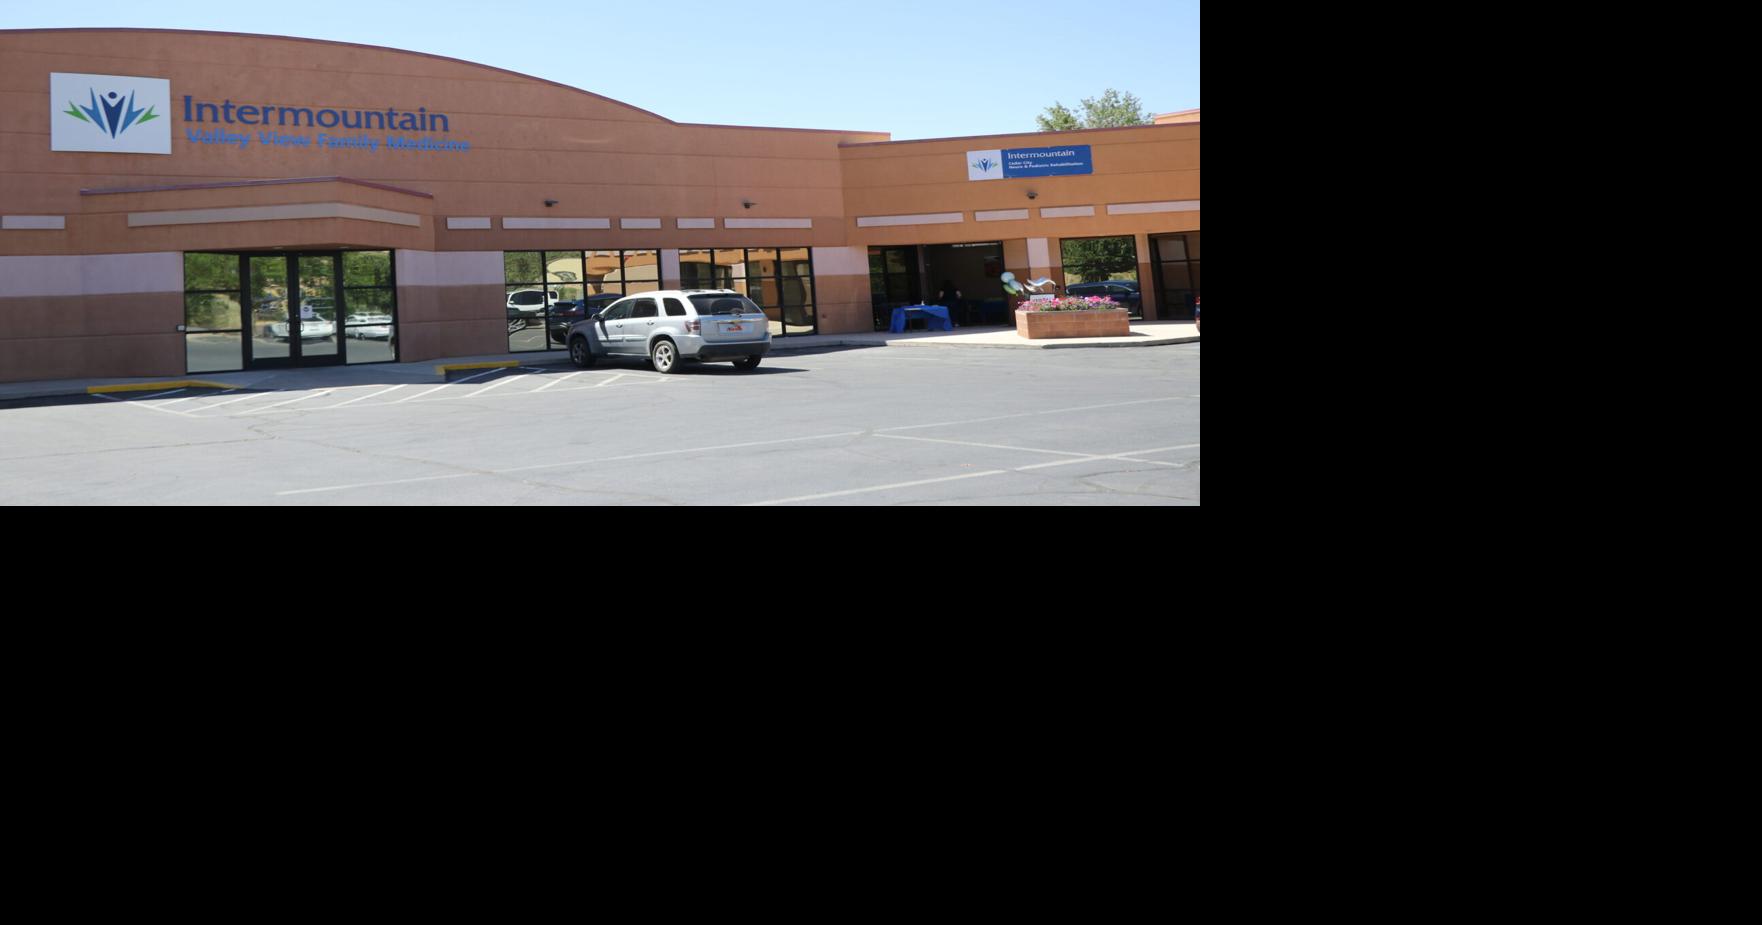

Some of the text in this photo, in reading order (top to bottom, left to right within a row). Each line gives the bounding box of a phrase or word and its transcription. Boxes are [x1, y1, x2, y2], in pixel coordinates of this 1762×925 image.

[183, 95, 450, 132] Intermountain
[185, 128, 471, 152] Valley View Family Medicine
[1007, 150, 1075, 159] Intermountain
